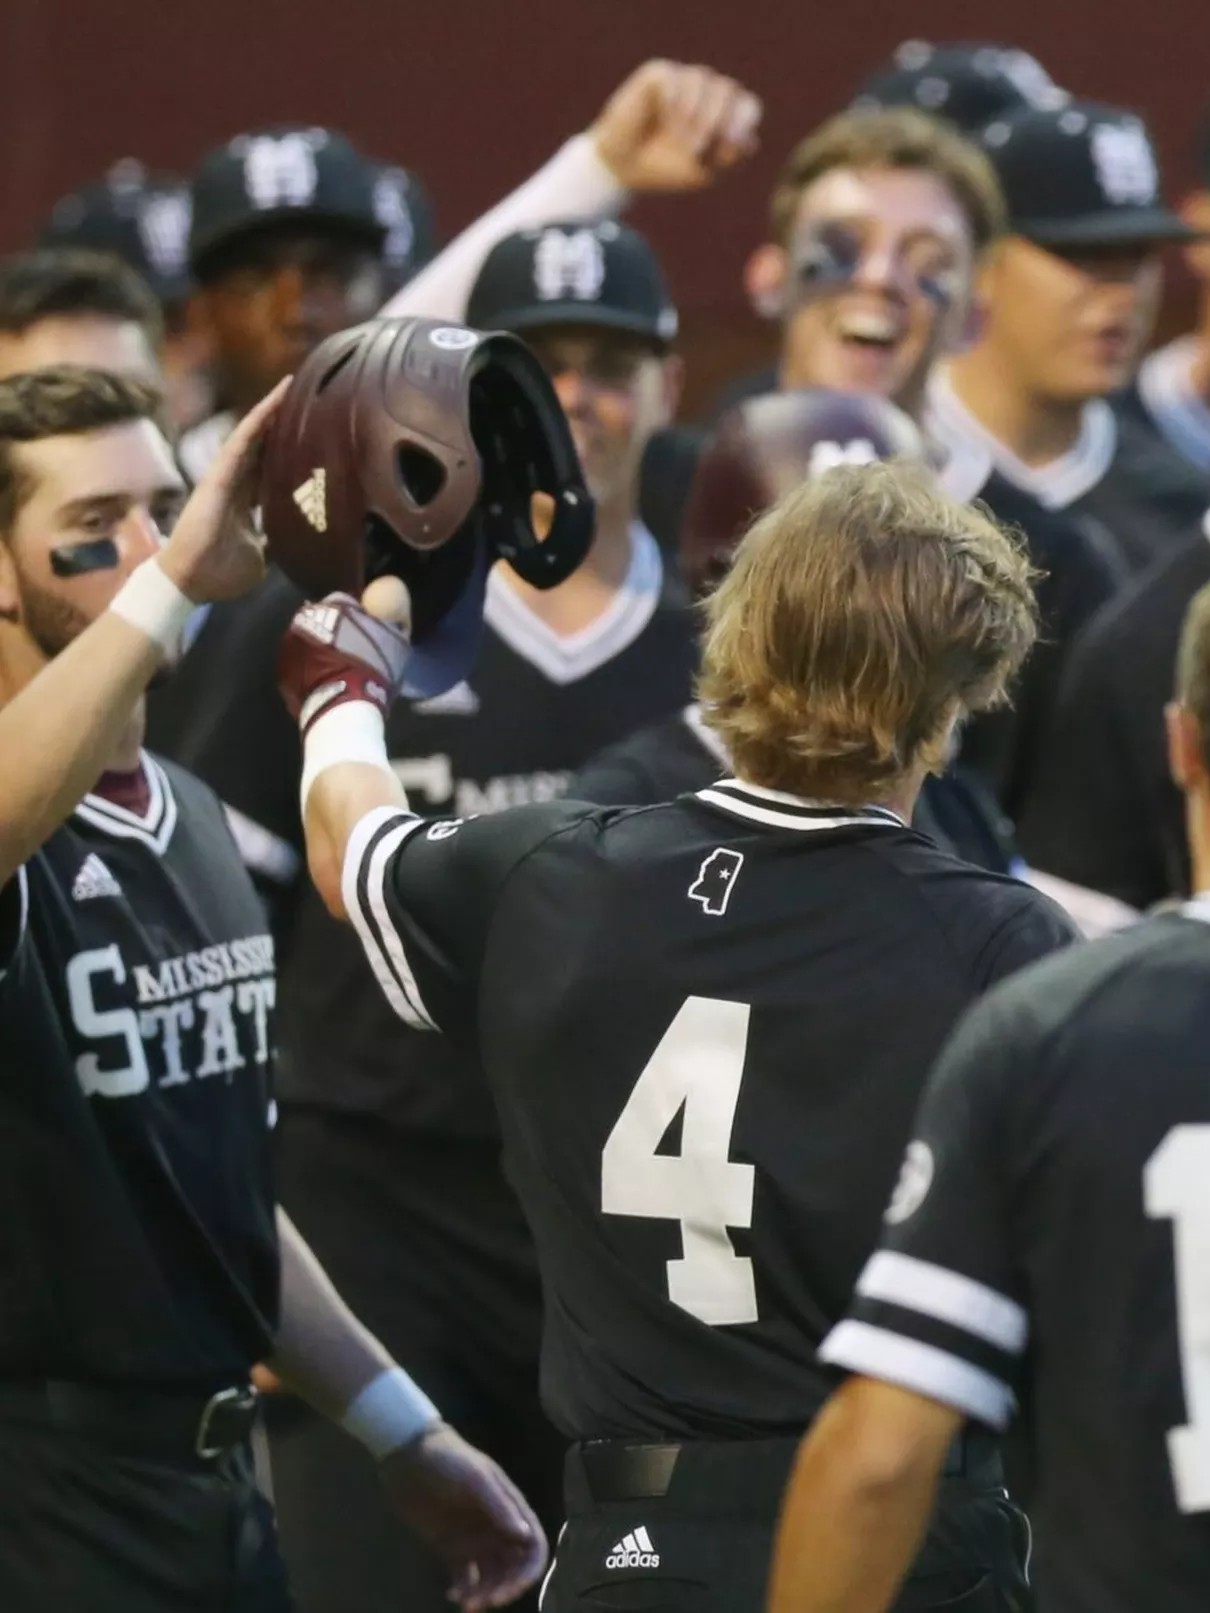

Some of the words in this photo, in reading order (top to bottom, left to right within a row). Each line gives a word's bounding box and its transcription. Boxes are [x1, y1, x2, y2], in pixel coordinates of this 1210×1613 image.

[66, 943, 277, 1098] STAT
[601, 995, 759, 1326] 4
[605, 1550, 661, 1569] adidas
